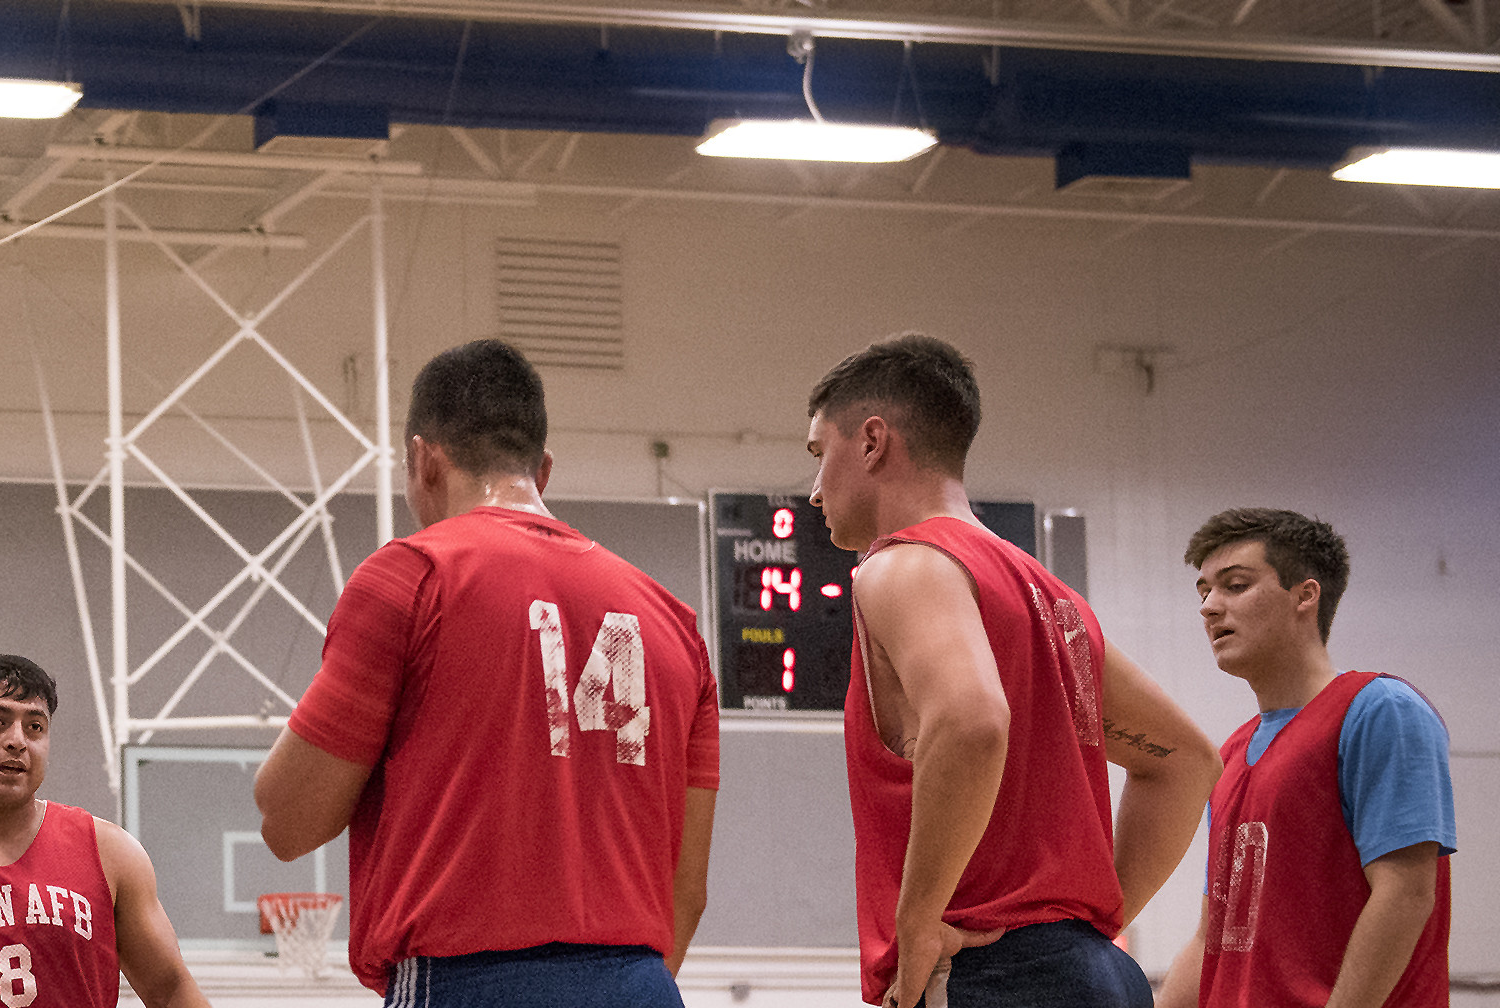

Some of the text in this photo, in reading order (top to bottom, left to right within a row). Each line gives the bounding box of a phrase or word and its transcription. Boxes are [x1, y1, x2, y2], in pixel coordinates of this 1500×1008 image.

[734, 540, 797, 564] HOME
[760, 567, 802, 612] 14
[528, 599, 650, 767] 14
[782, 647, 796, 693] 1
[25, 883, 93, 941] AFB
